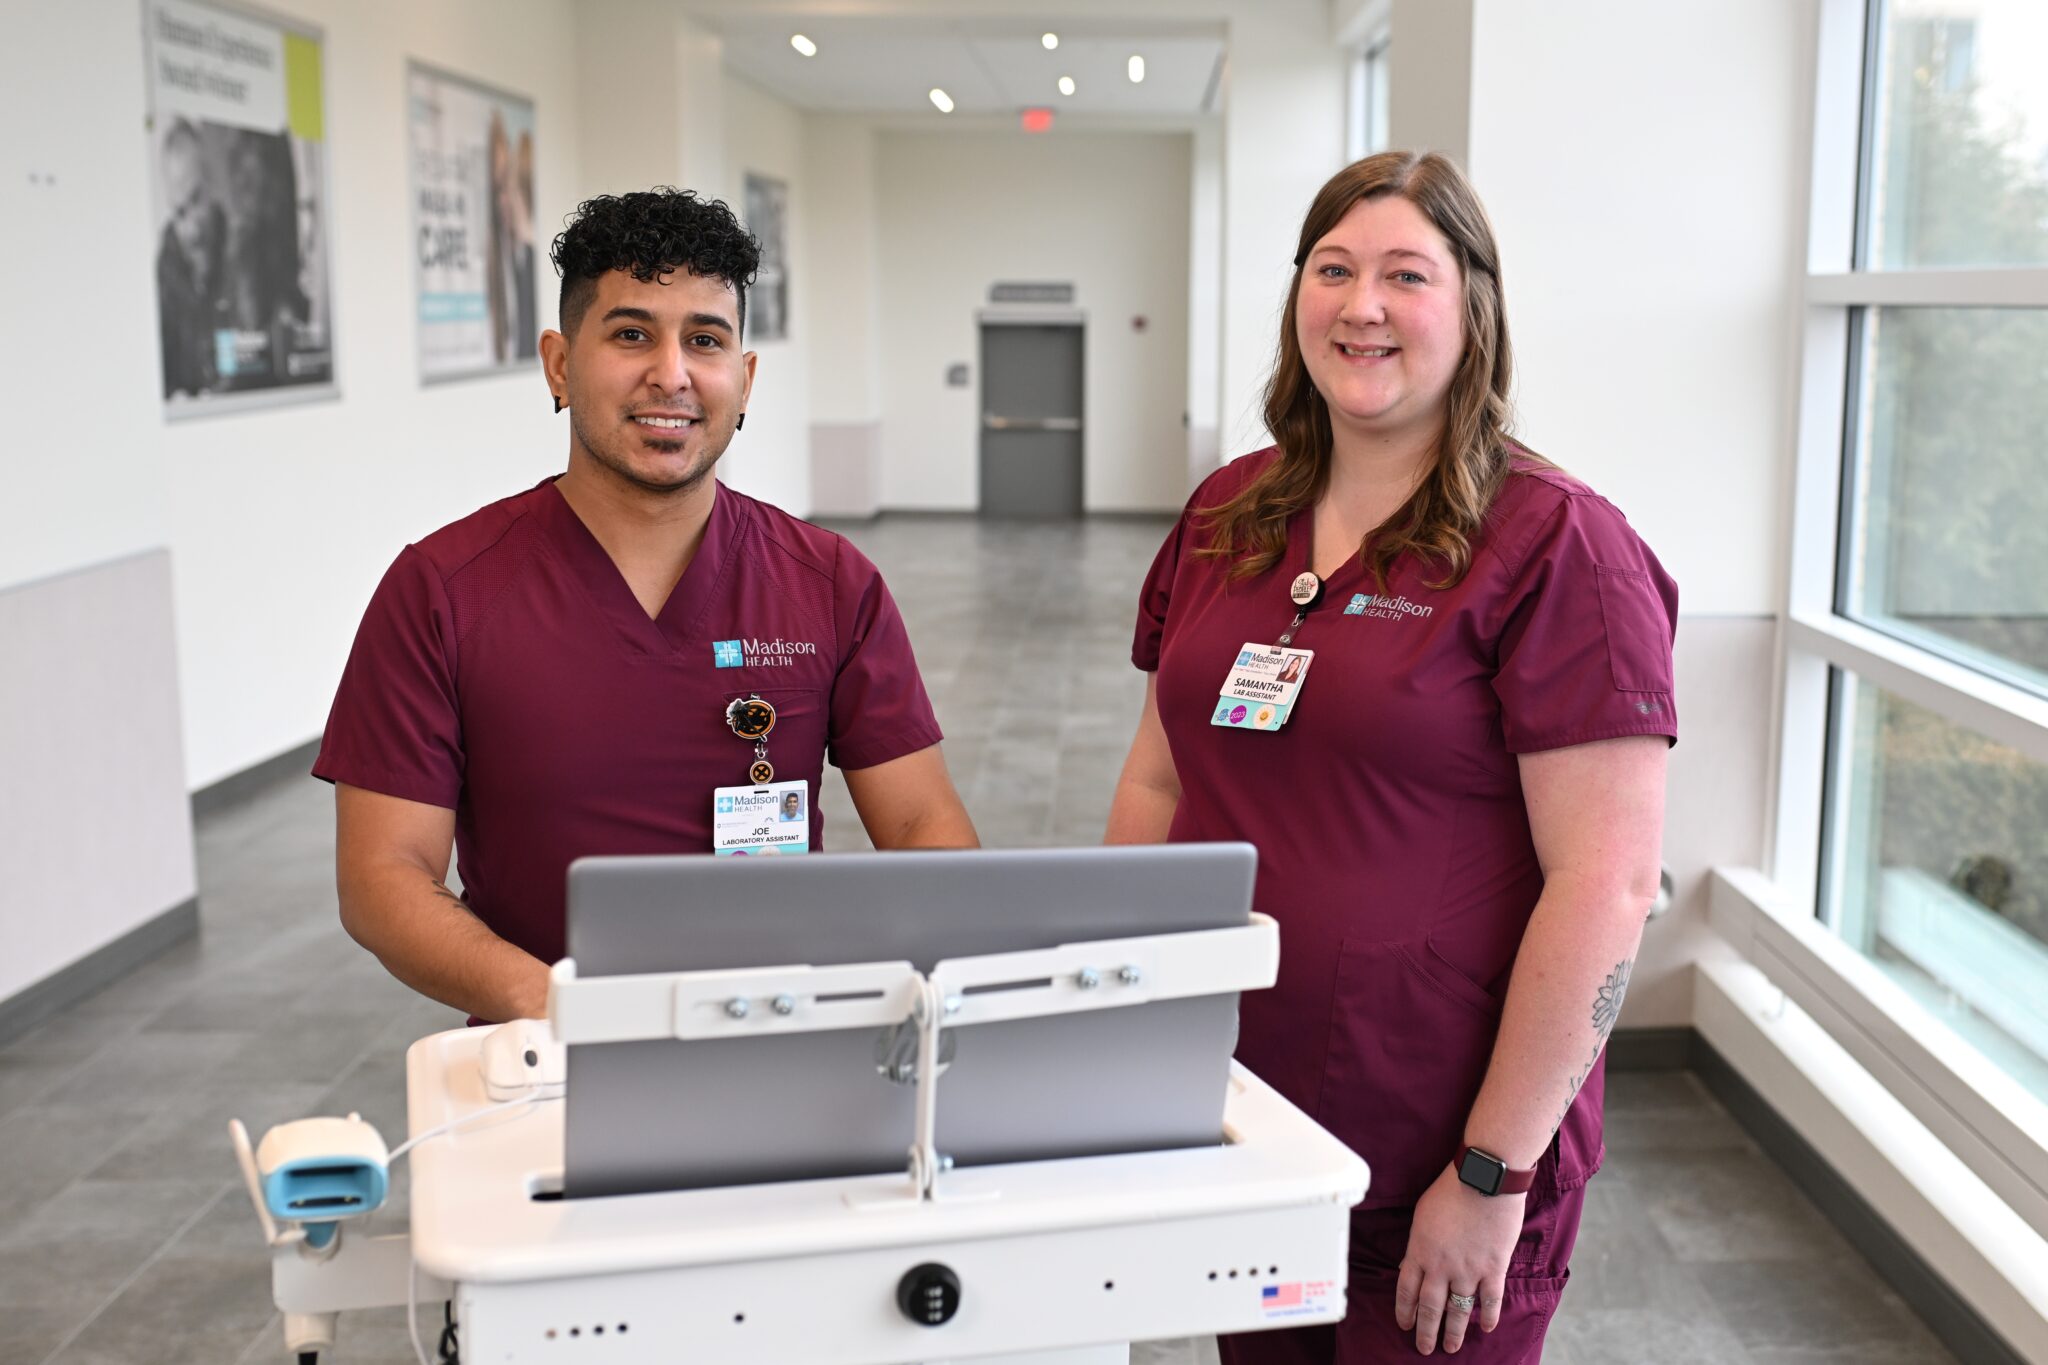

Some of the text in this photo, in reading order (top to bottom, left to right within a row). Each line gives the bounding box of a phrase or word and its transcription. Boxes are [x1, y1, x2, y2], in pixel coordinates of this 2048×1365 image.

[1368, 594, 1433, 618] Madison
[1362, 608, 1403, 621] HEALTH
[743, 638, 816, 655] Madison
[746, 656, 793, 667] HEALTH
[1251, 653, 1284, 666] Madison
[1234, 678, 1284, 693] SAMANTHA
[1245, 690, 1277, 701] ASSISTANT
[734, 795, 778, 806] Madison
[734, 805, 763, 813] HEALTH
[752, 827, 770, 836] JOE
[722, 837, 764, 846] LABORATORY
